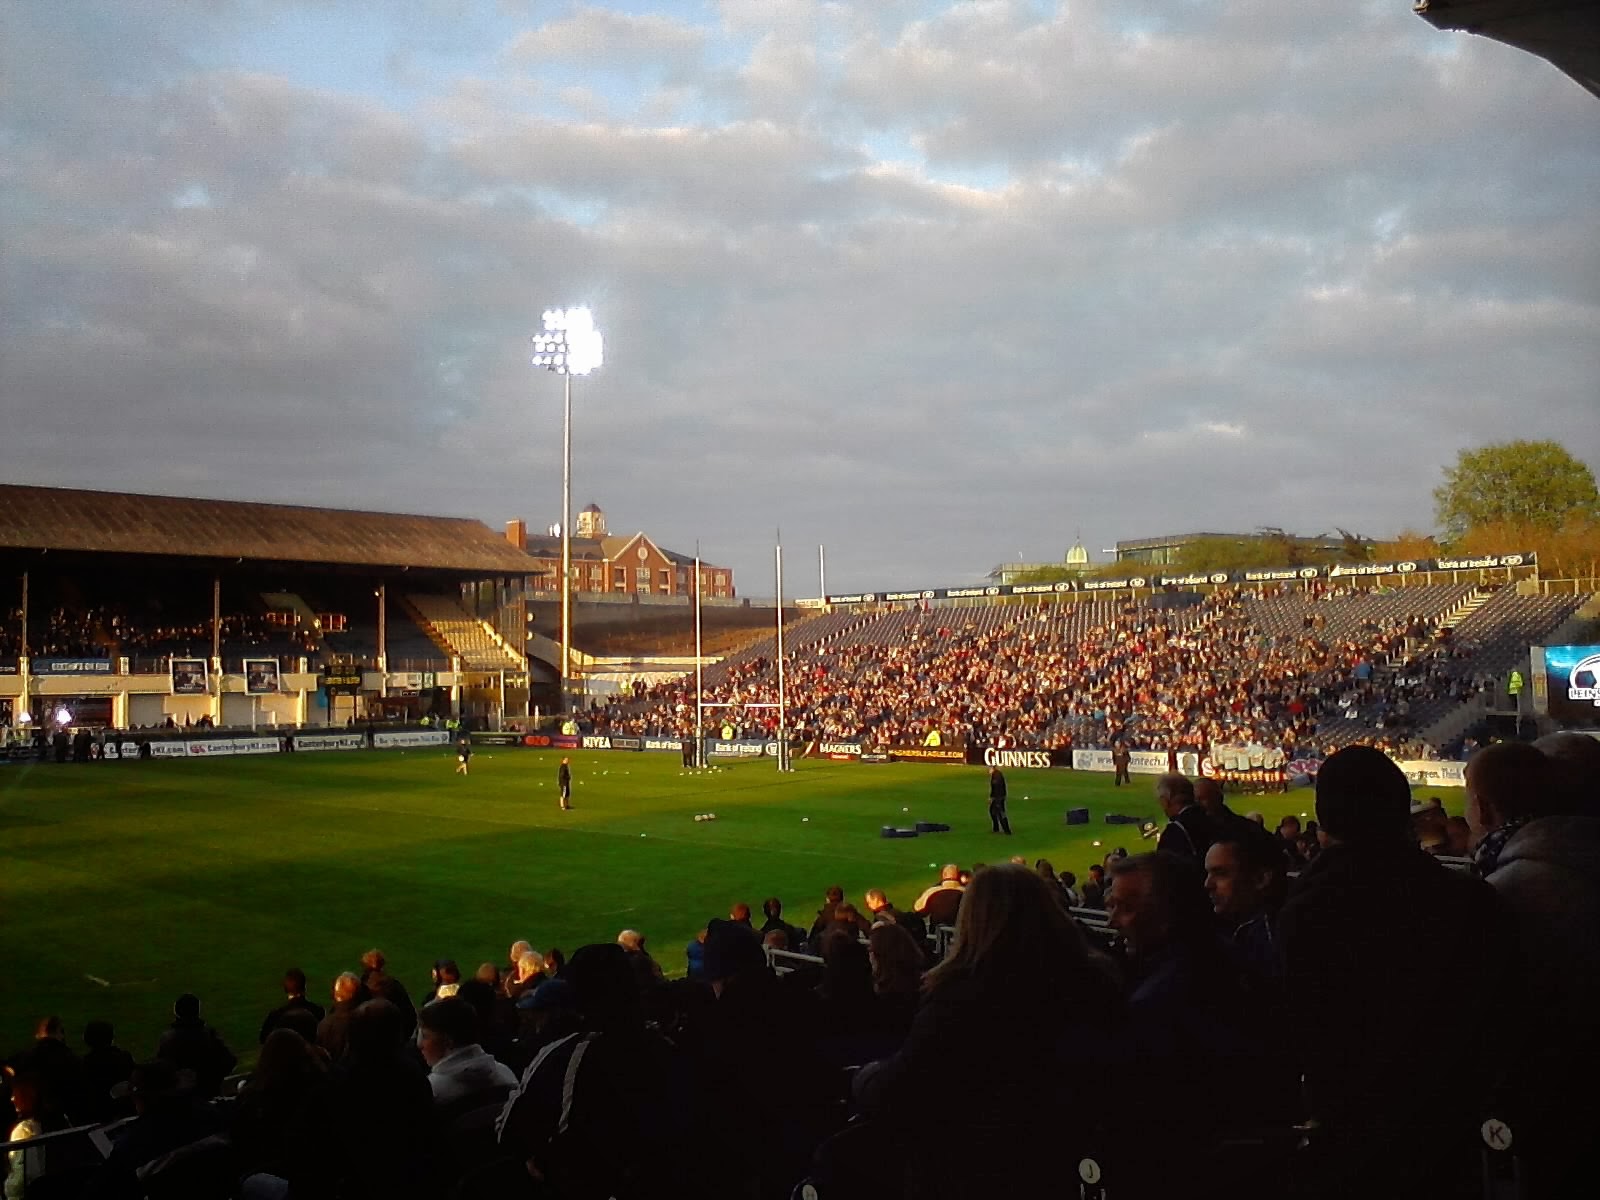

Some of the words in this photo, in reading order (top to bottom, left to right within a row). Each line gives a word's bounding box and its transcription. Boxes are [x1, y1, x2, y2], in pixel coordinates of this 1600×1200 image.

[582, 736, 611, 749] NIVEA
[820, 743, 862, 754] MAGNERS
[984, 747, 1051, 768] GUINNESS
